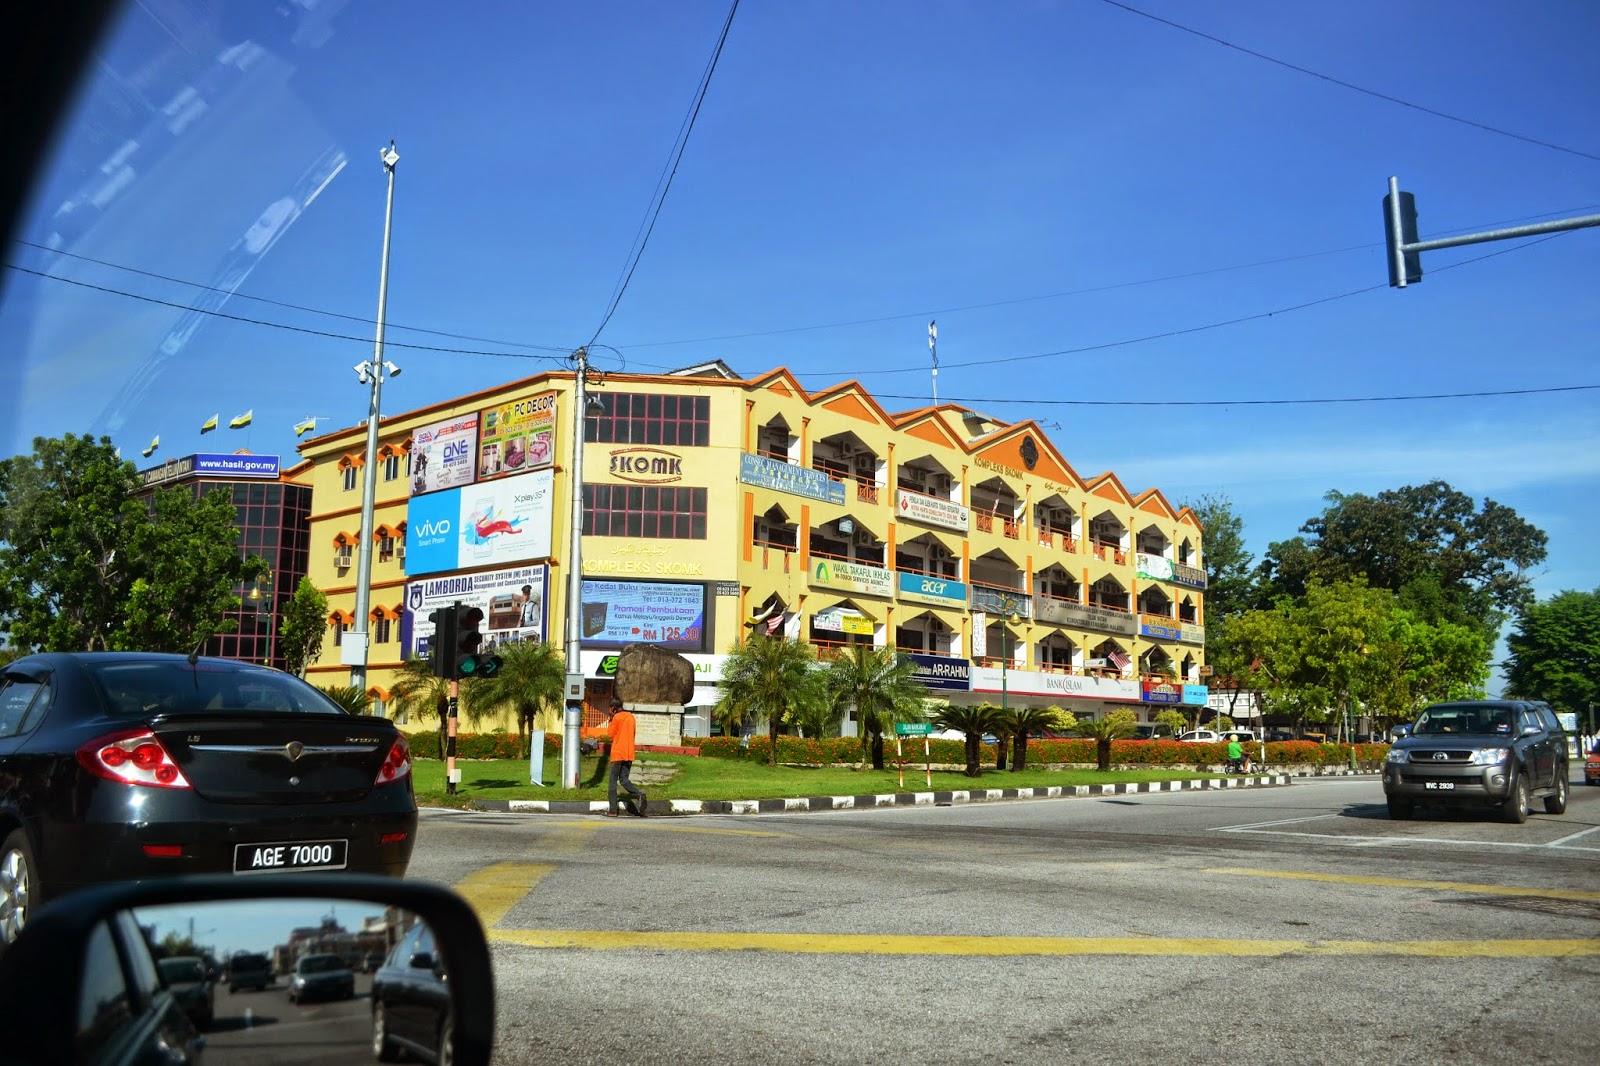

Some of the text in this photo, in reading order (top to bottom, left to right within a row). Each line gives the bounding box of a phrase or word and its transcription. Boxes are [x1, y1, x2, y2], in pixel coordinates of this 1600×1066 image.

[514, 395, 554, 418] PC DECOR
[444, 440, 468, 458] ONE
[200, 460, 276, 472] www.hasil.gov.my
[610, 454, 682, 475] SKOMK
[766, 460, 802, 476] MANAGEMENT
[804, 468, 826, 482] SERVICES
[974, 457, 1024, 480] KOMPLEKS SKOMK
[415, 520, 450, 538] vivo
[582, 559, 703, 576] KOMPLEKS SKOMK
[832, 562, 890, 581] WAKIL TAKAFUL IKHLAS
[474, 574, 494, 583] SECURITY
[495, 571, 512, 580] SYSTEM
[424, 577, 473, 596] LAMBORDA
[474, 582, 496, 590] Management
[921, 578, 947, 594] acer
[614, 605, 695, 614] Promosi Pembukaan
[643, 630, 656, 640] RM
[695, 664, 712, 673] AJI
[932, 663, 969, 678] AR-RAHNU
[1047, 677, 1082, 691] BANK ISLAM
[252, 845, 332, 866] AGE 7000
